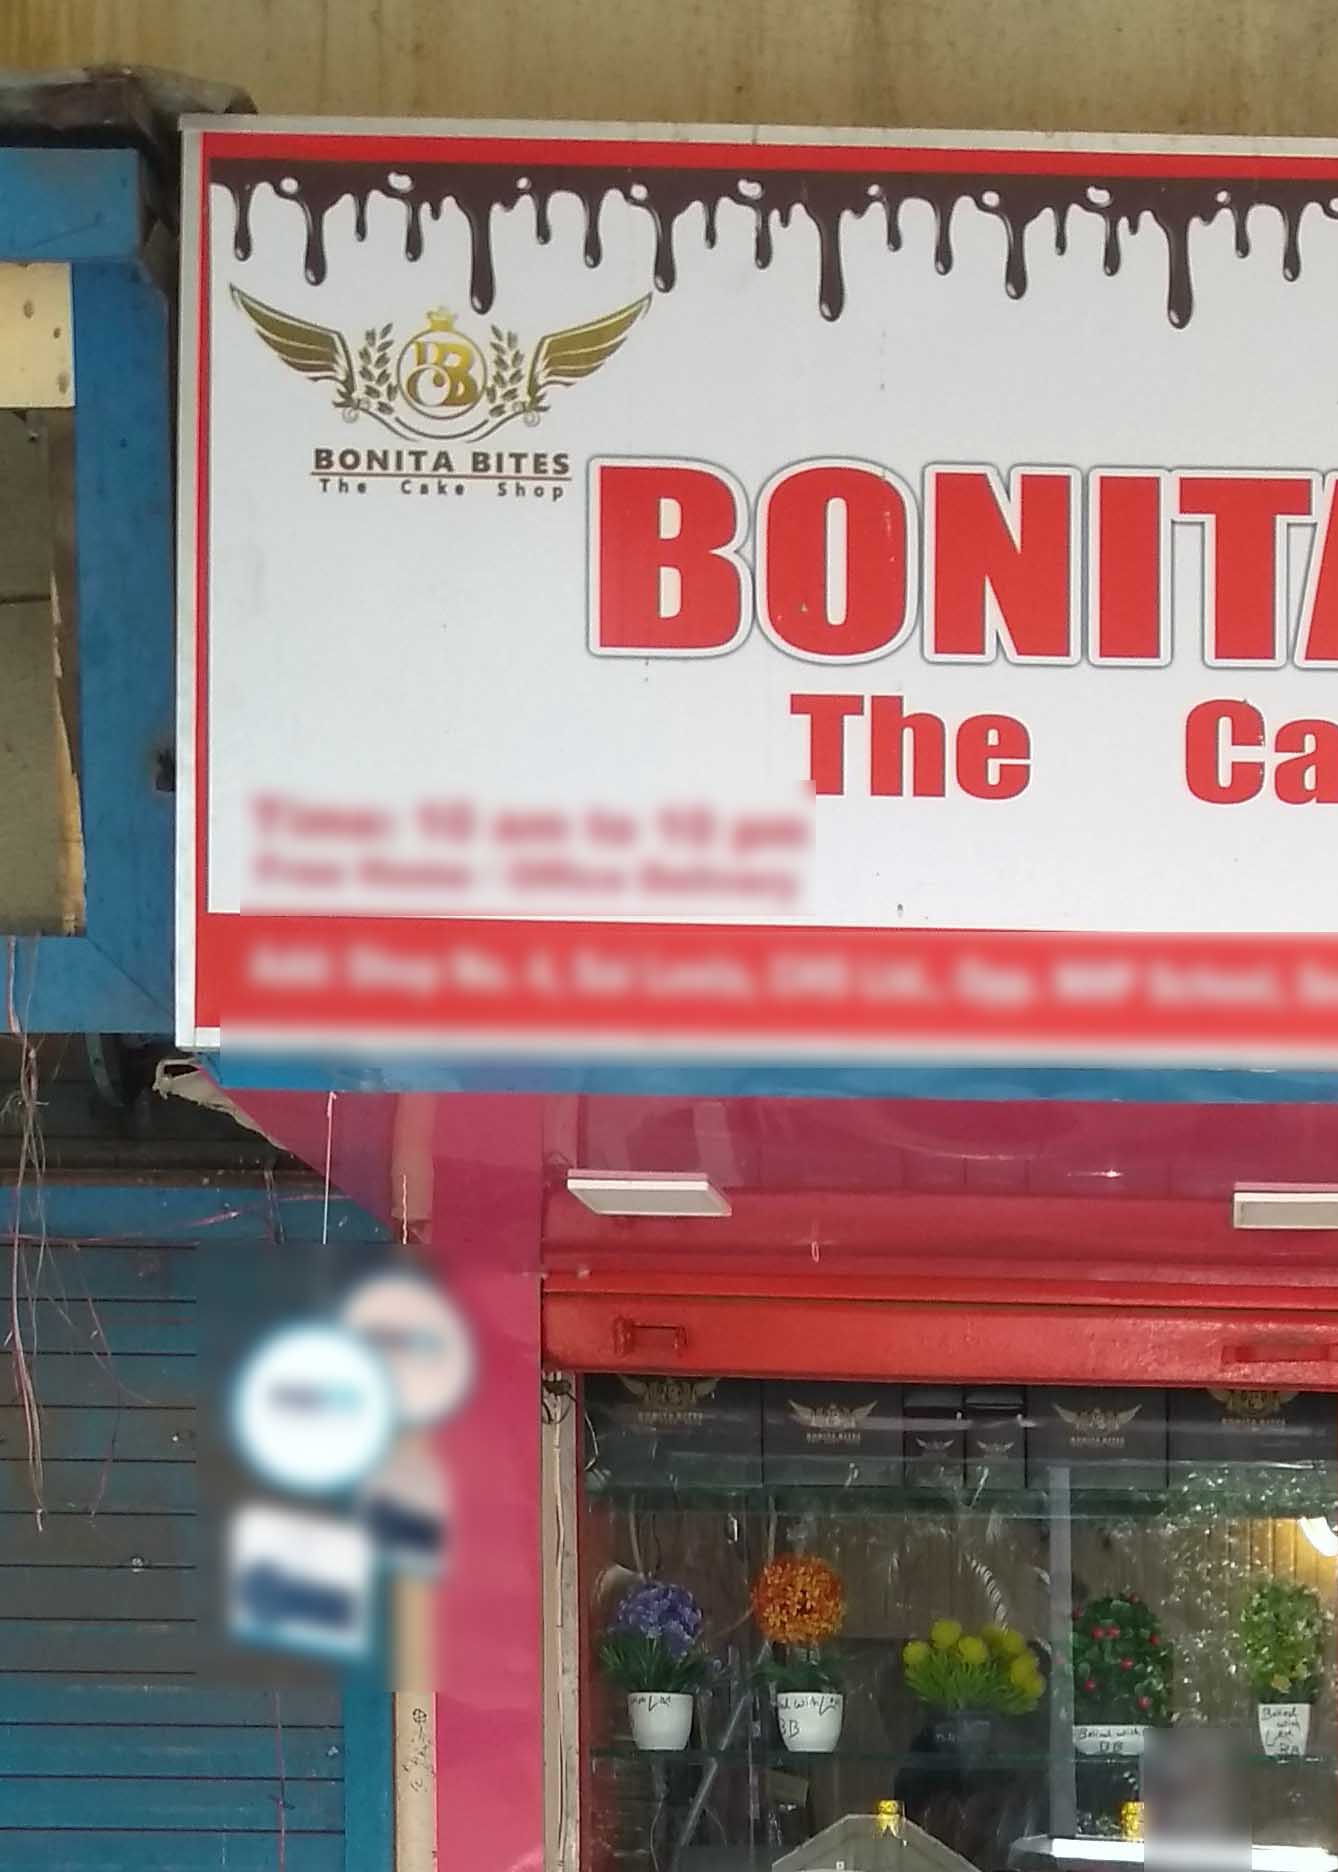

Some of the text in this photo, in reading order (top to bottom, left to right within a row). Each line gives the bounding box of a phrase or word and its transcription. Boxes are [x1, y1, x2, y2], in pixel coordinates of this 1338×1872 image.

[314, 448, 570, 475] BONITA BITES
[318, 478, 564, 502] The Cake Shop
[788, 692, 1032, 801] The
